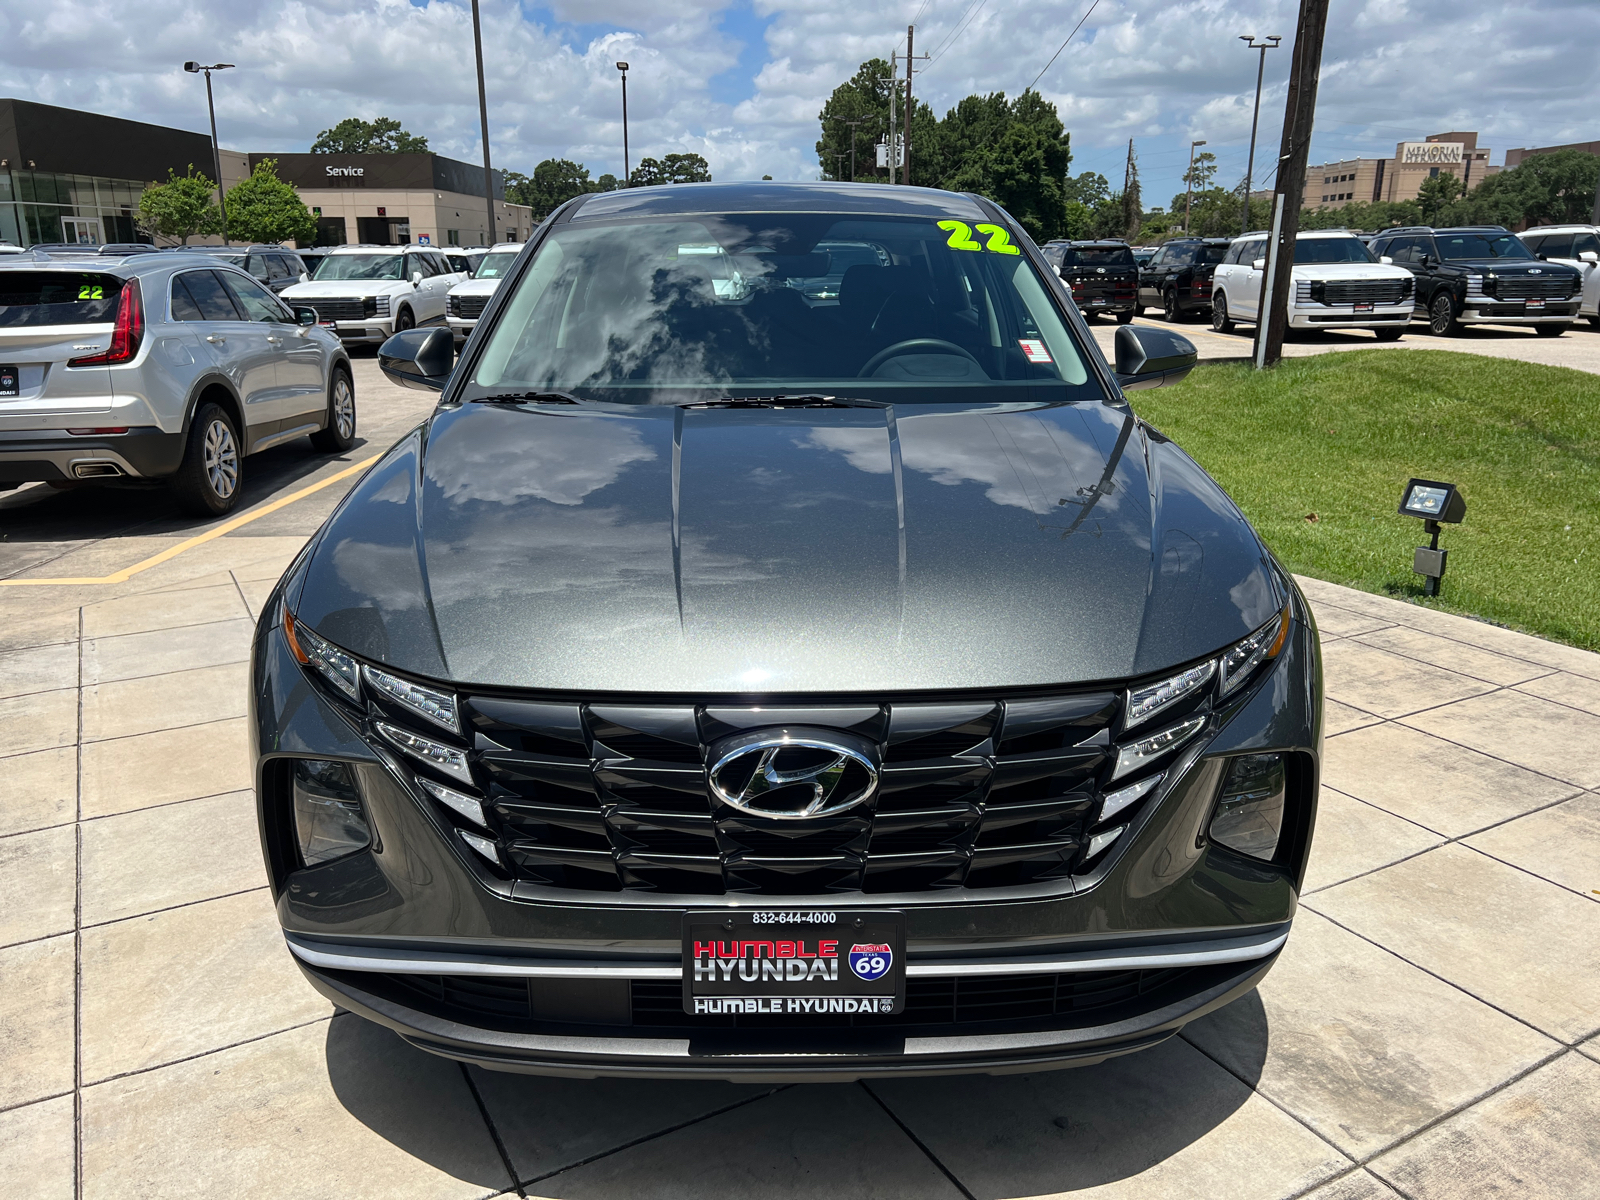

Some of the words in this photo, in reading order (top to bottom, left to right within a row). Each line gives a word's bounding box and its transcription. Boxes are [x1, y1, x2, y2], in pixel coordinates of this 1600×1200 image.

[1405, 154, 1460, 162] HERMANN
[1407, 146, 1460, 155] MEMORIAL
[326, 166, 364, 176] Service
[936, 220, 1022, 256] 22
[78, 285, 103, 300] 22
[752, 912, 837, 924] 832-644-4000
[694, 940, 839, 959] HUMBLE
[855, 944, 886, 952] INTERSTATE
[694, 959, 839, 982] HYUNDAI
[855, 957, 885, 974] 69
[694, 999, 783, 1014] HUMBLE
[787, 999, 878, 1013] HYUNDAI
